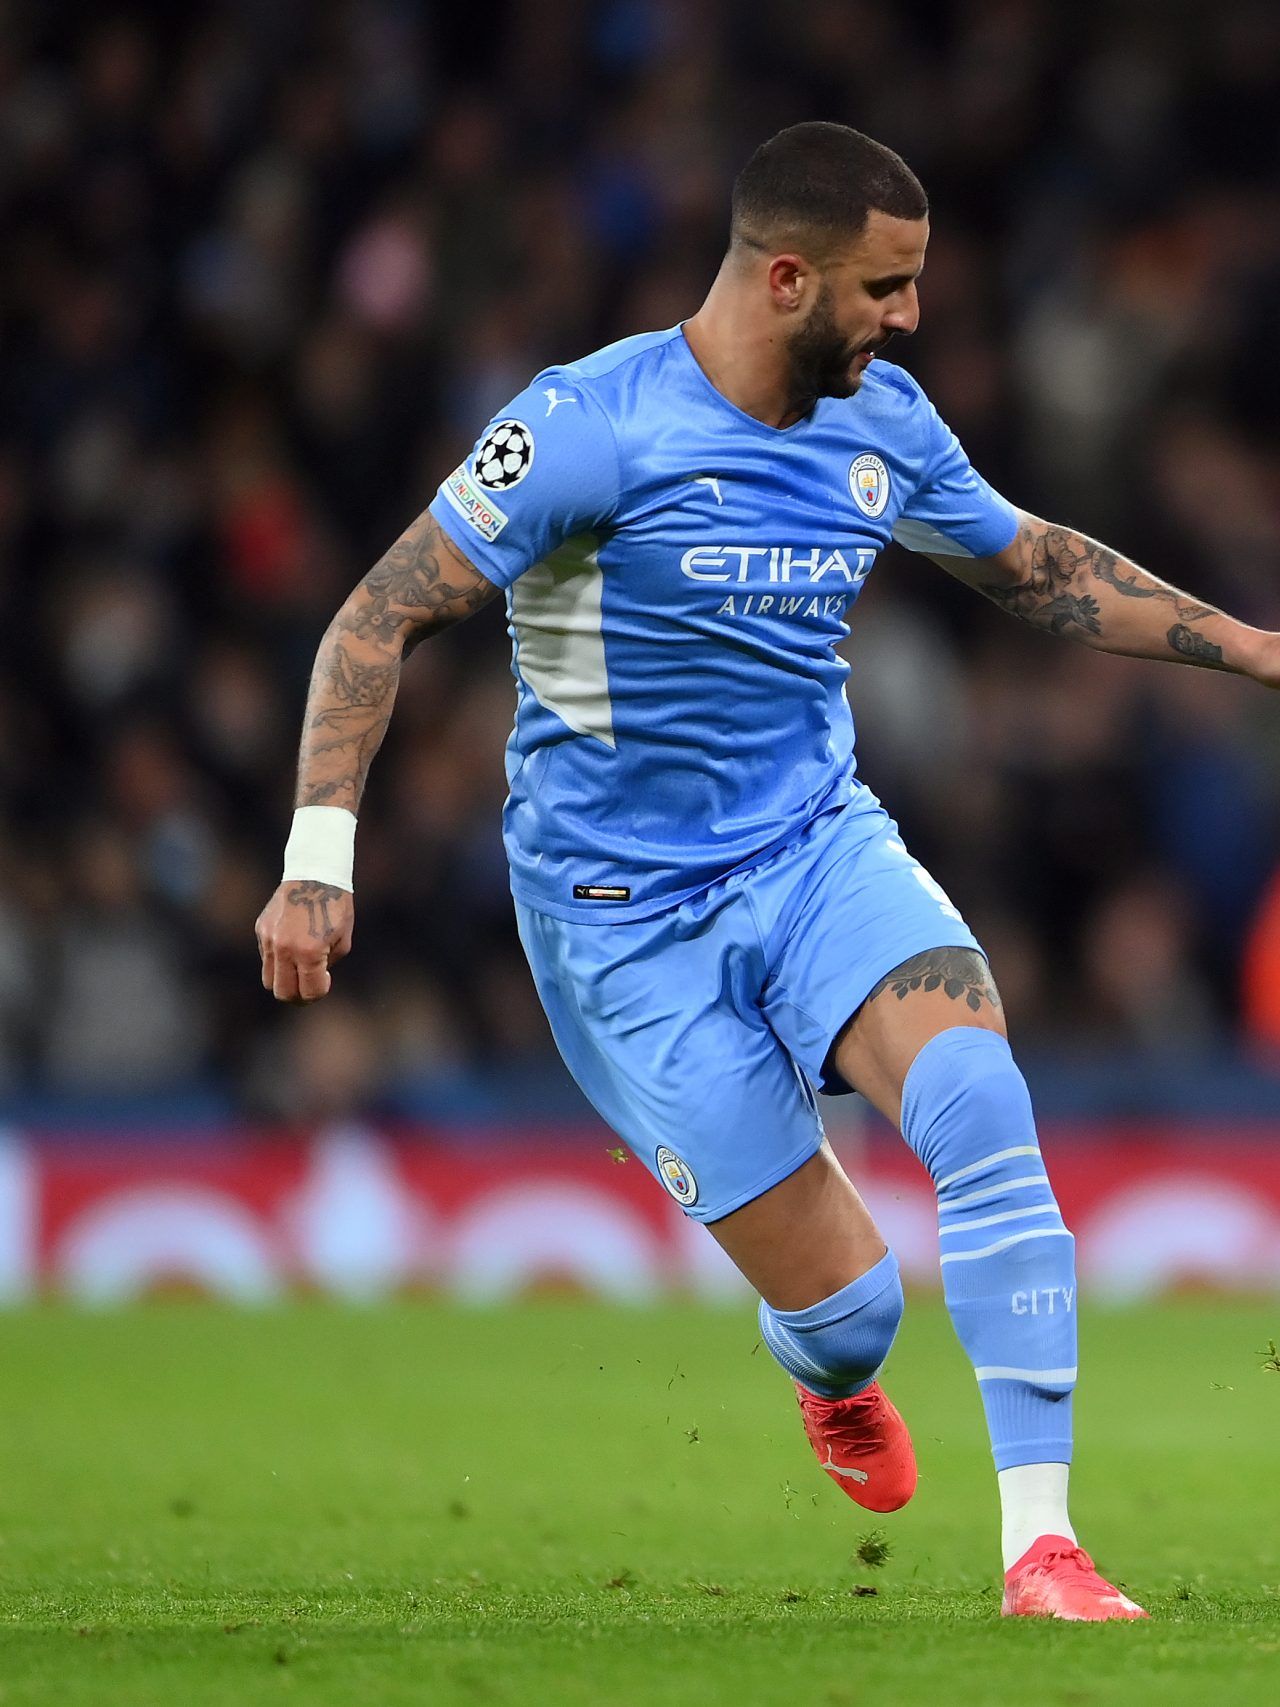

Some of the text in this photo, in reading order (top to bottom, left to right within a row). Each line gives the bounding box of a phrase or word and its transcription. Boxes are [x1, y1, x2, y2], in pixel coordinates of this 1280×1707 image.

[851, 456, 885, 477] MANCHESTER
[680, 546, 877, 583] ETIHAD
[717, 594, 847, 618] AIRWAYS
[1011, 1286, 1074, 1315] CITY
